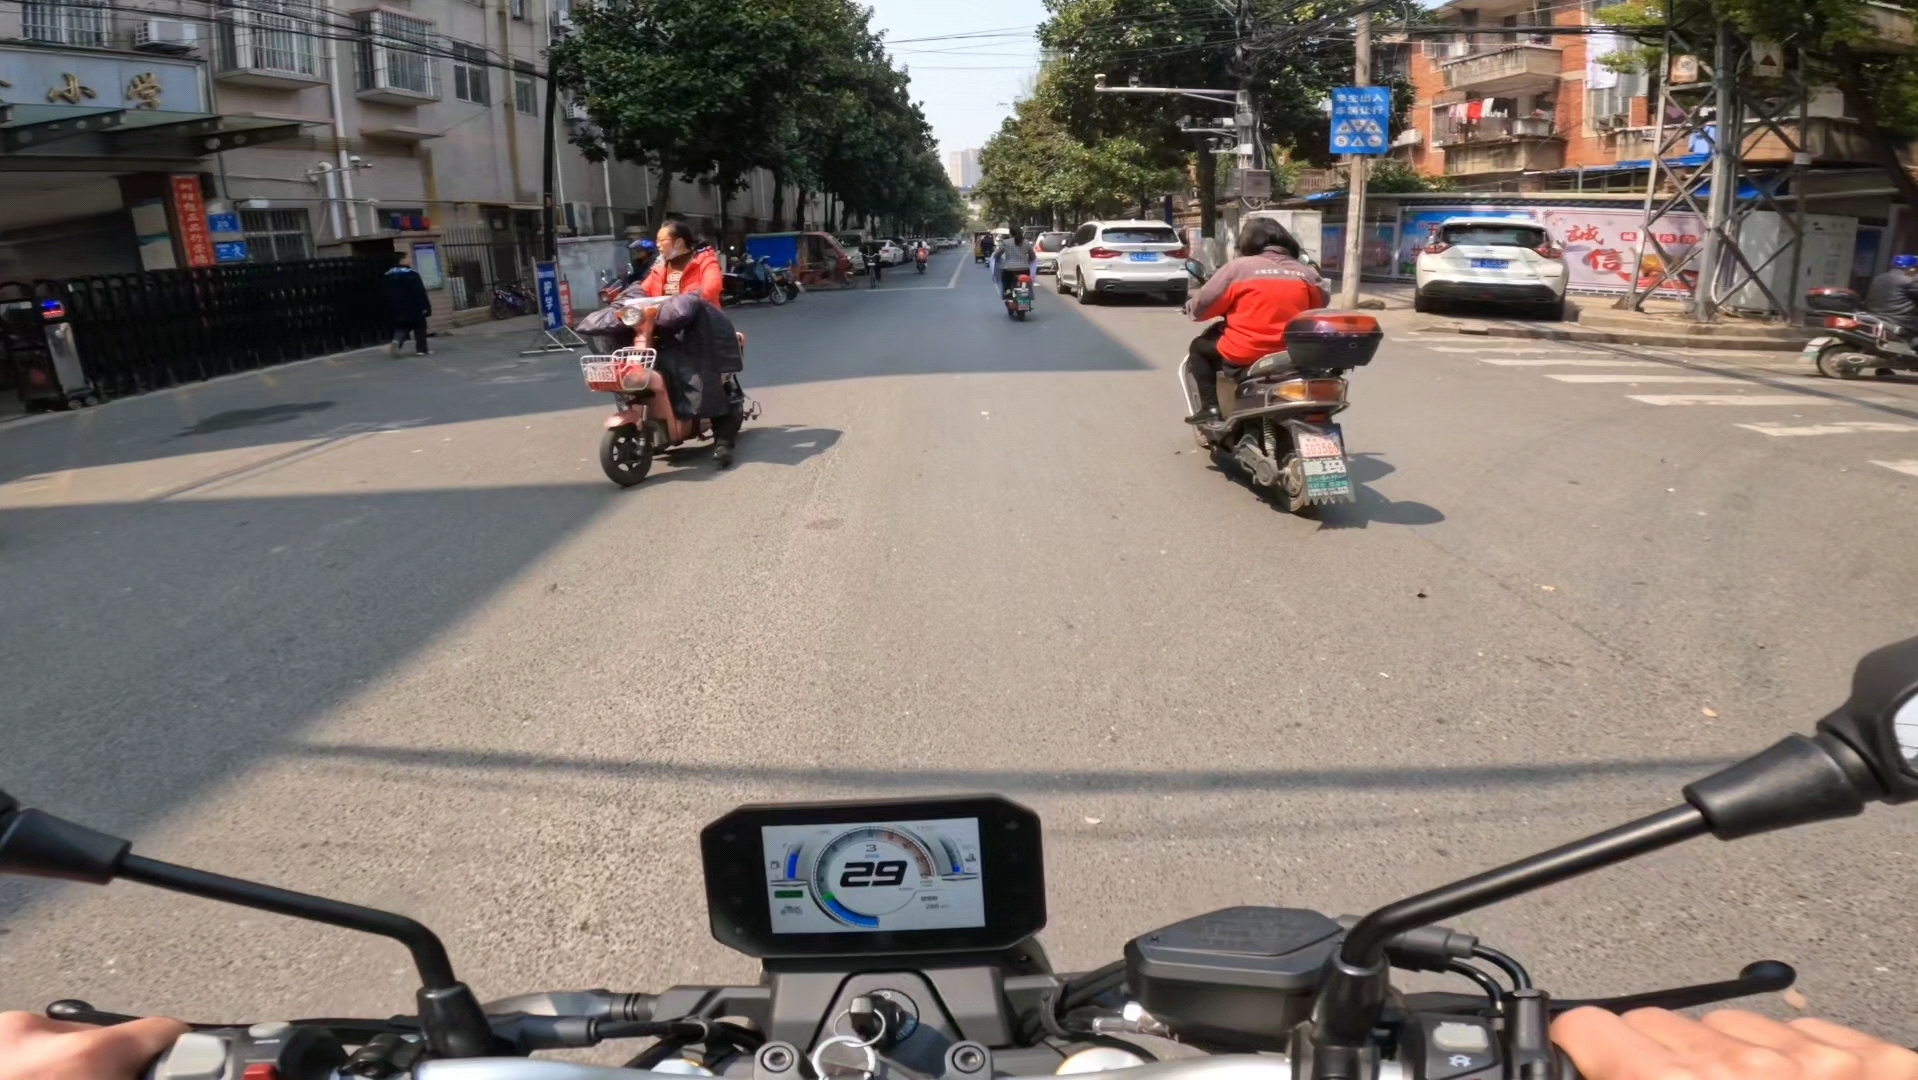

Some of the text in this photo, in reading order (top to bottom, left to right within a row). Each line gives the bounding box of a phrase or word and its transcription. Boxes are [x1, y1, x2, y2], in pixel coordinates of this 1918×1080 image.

[1336, 93, 1384, 103] 学生出入
[866, 843, 877, 852] 3
[839, 860, 908, 888] 29
